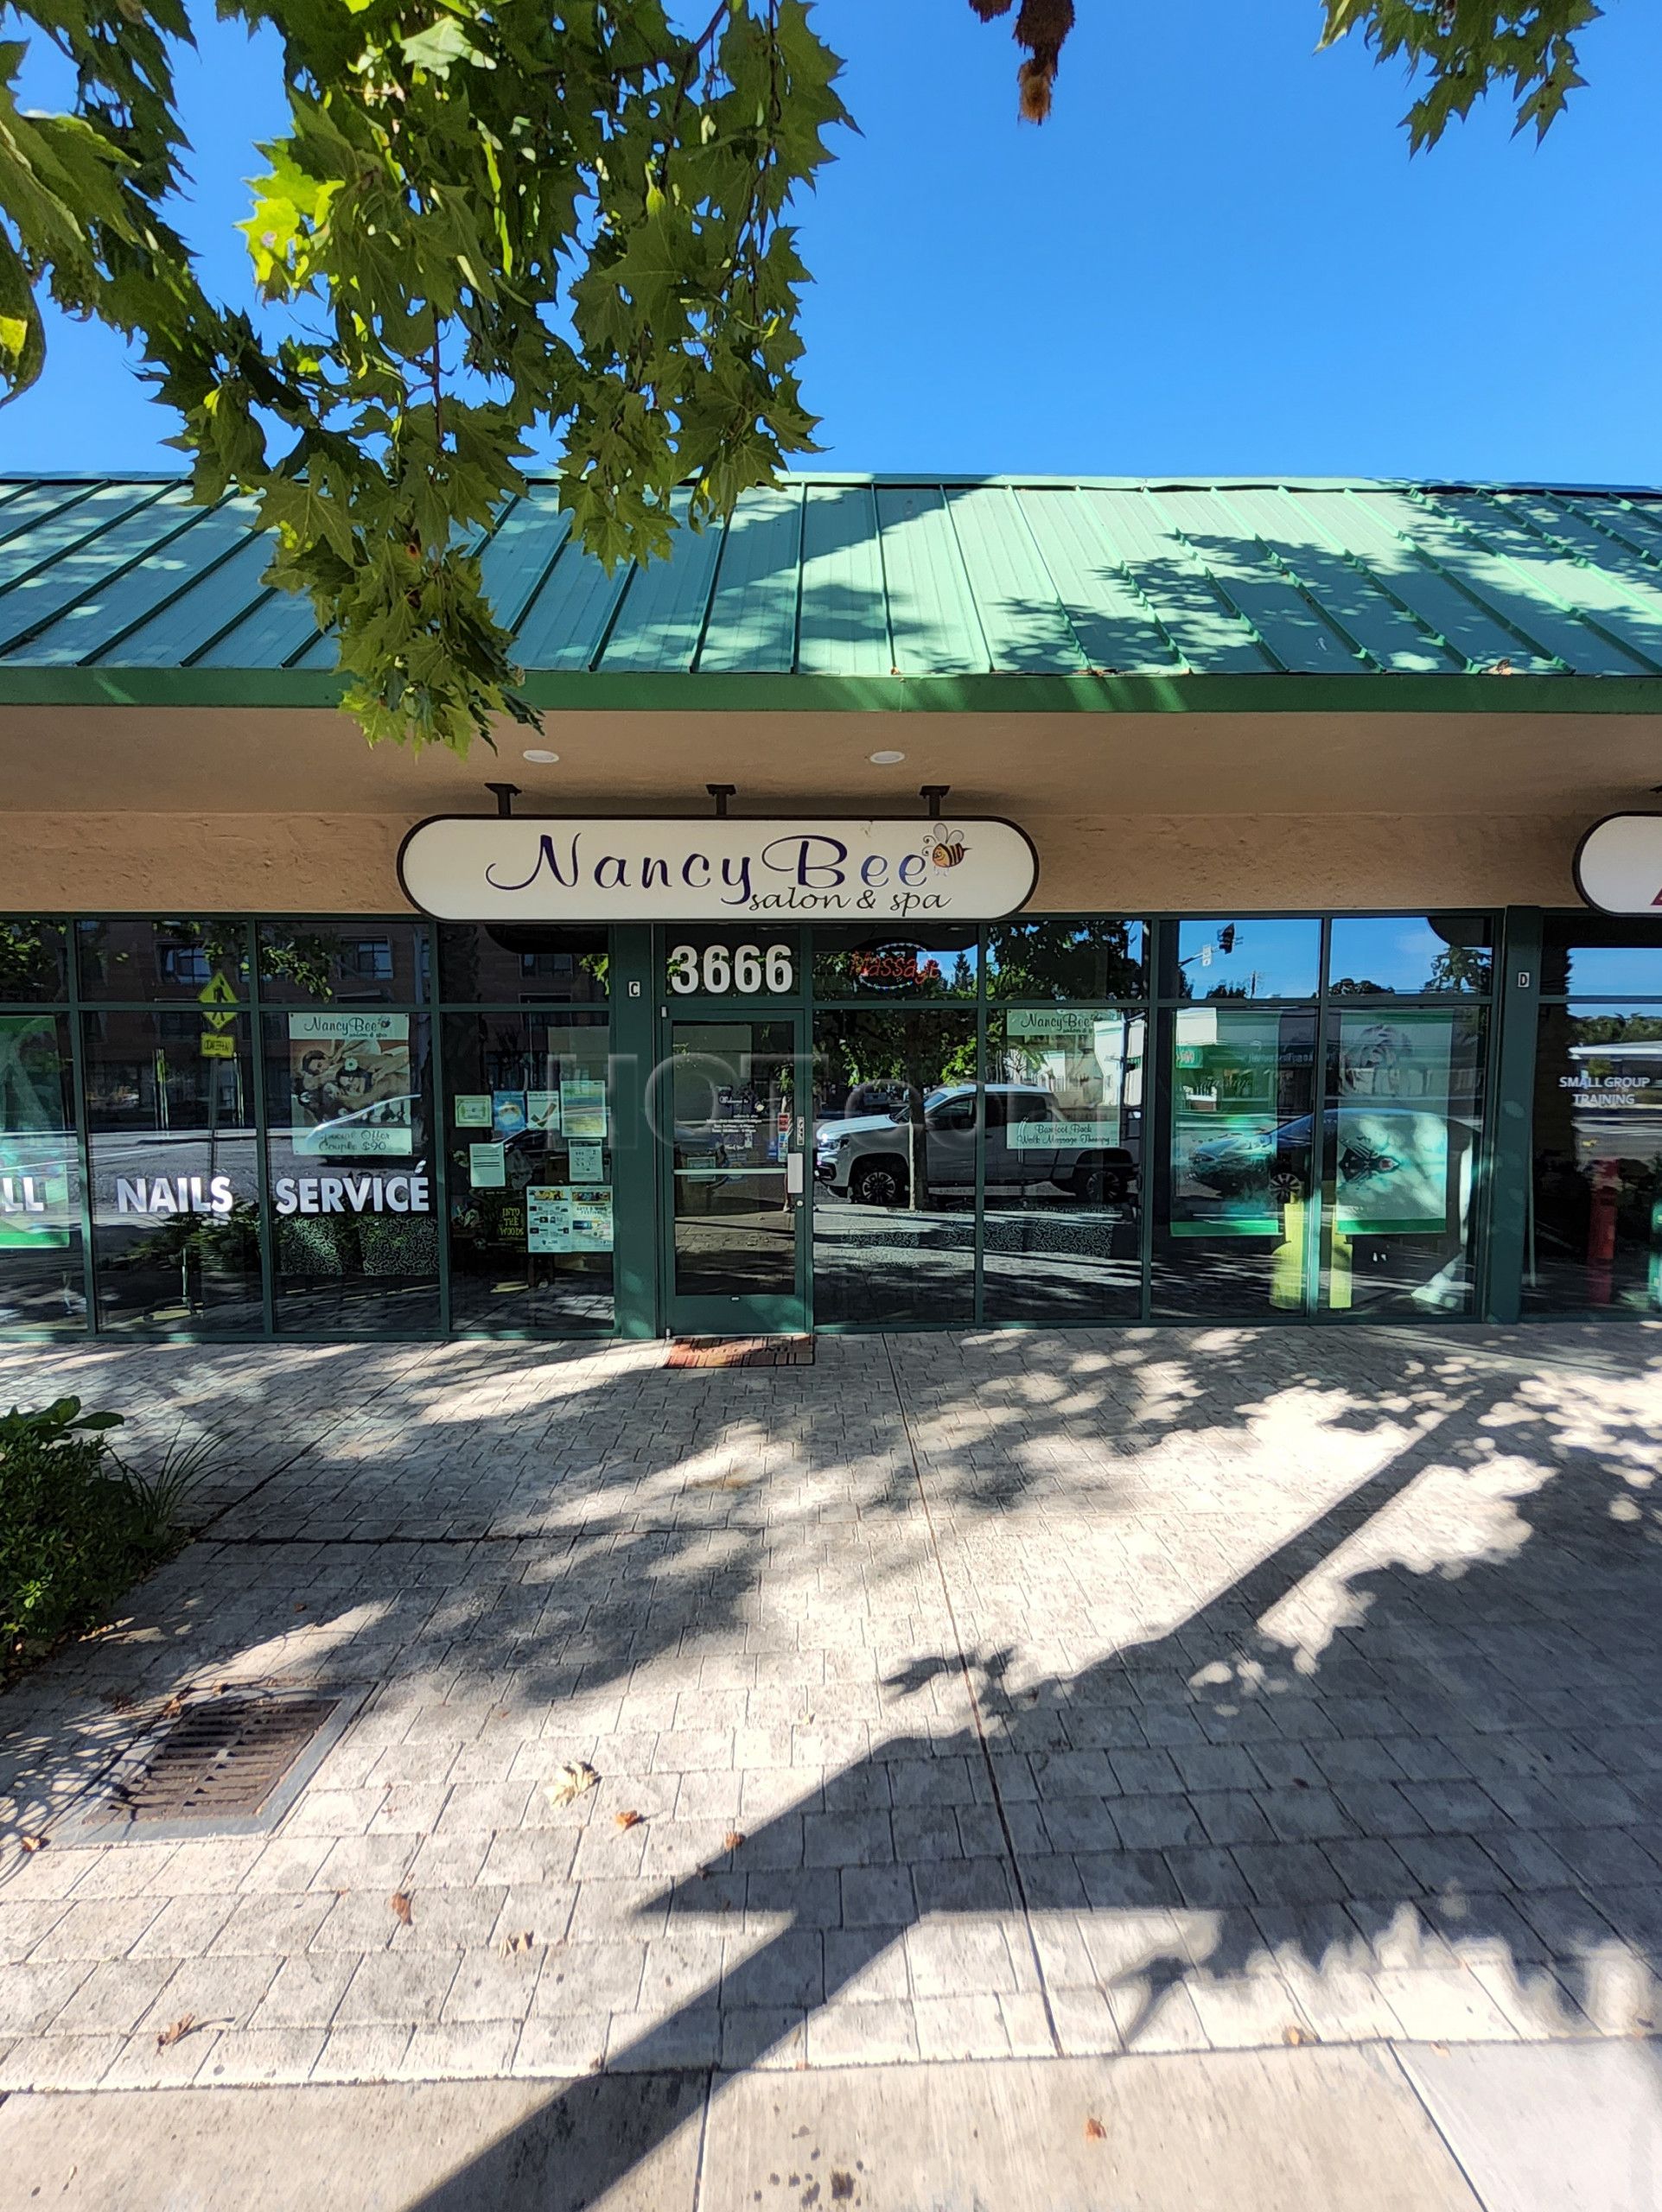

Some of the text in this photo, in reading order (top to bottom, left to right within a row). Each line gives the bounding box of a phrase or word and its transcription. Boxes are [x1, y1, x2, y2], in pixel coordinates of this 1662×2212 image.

[486, 833, 927, 905] Nancy Bee
[749, 887, 952, 917] salon & spa
[671, 944, 793, 994] 3666
[630, 982, 639, 995] C
[1519, 973, 1528, 987] D
[304, 1016, 377, 1036] Nancy Bee
[1021, 1013, 1090, 1031] Nancy Bee
[1558, 1077, 1650, 1089] SMALL GROUP
[1572, 1094, 1635, 1105] TRAINING
[117, 1176, 233, 1214] NAILS
[276, 1176, 430, 1215] SERVICE
